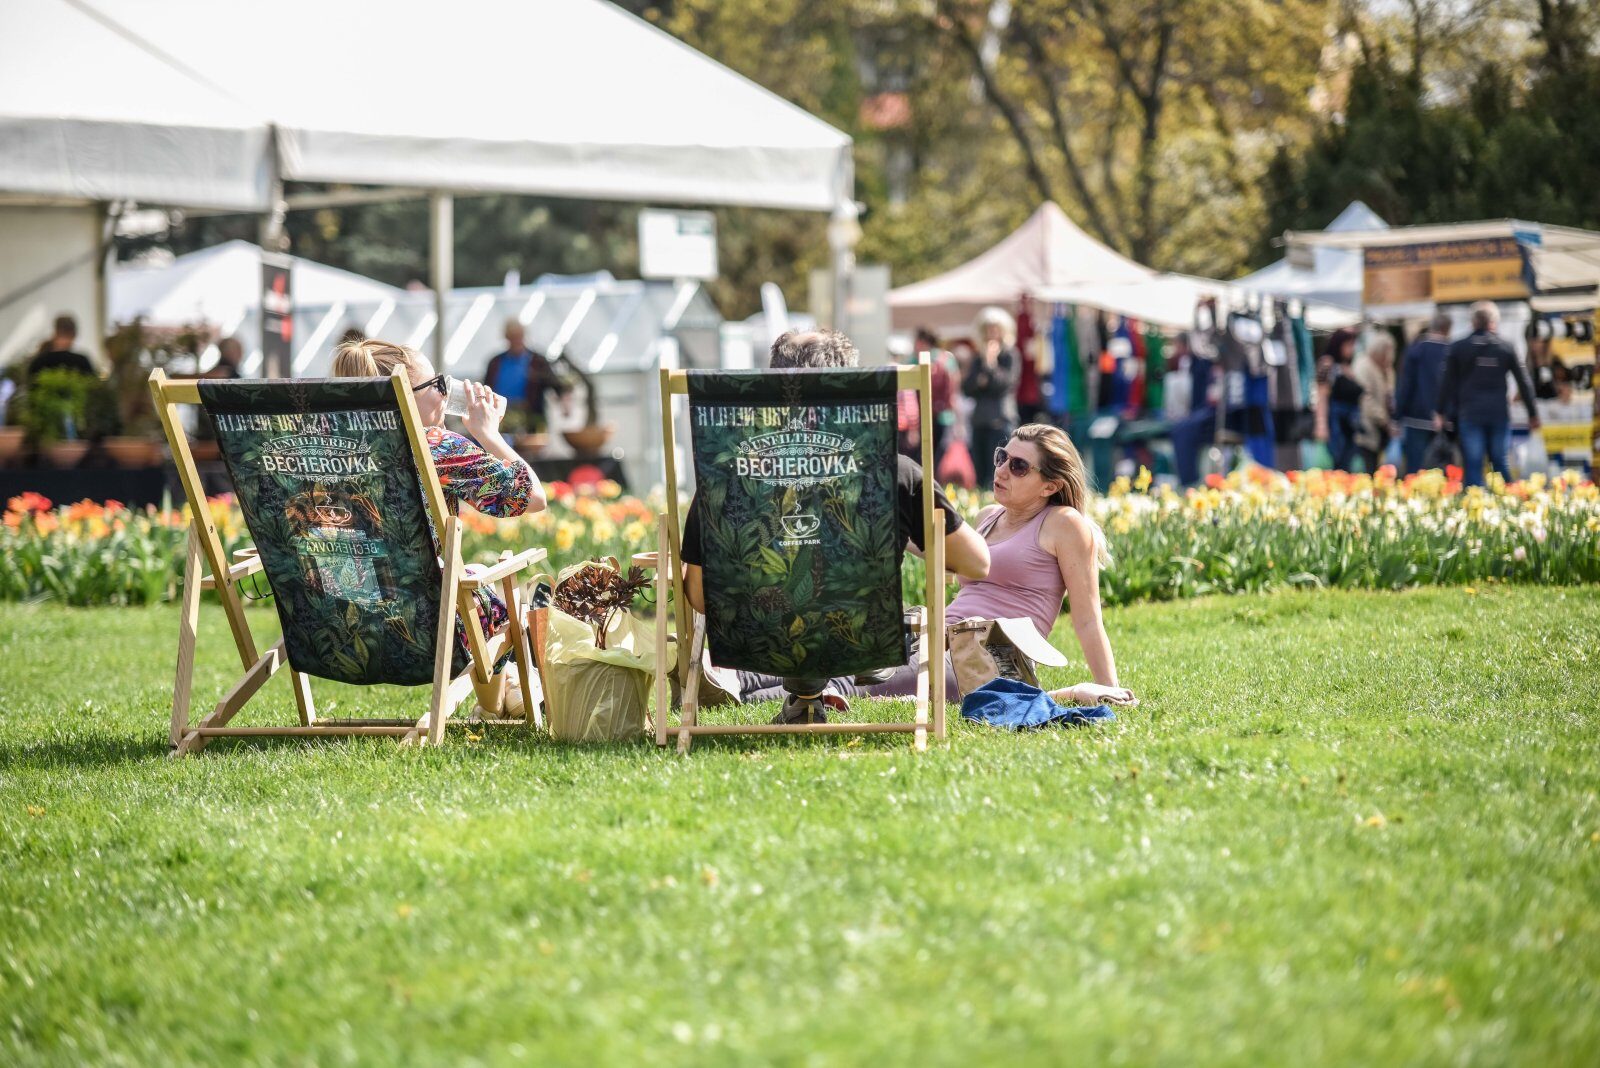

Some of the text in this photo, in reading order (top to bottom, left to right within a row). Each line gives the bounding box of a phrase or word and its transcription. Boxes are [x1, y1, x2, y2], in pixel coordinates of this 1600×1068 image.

[273, 437, 357, 450] UNFILTERED
[750, 433, 841, 451] UNFILTERED
[262, 455, 379, 473] BECHEROVKA
[736, 455, 859, 477] BECHEROVKA
